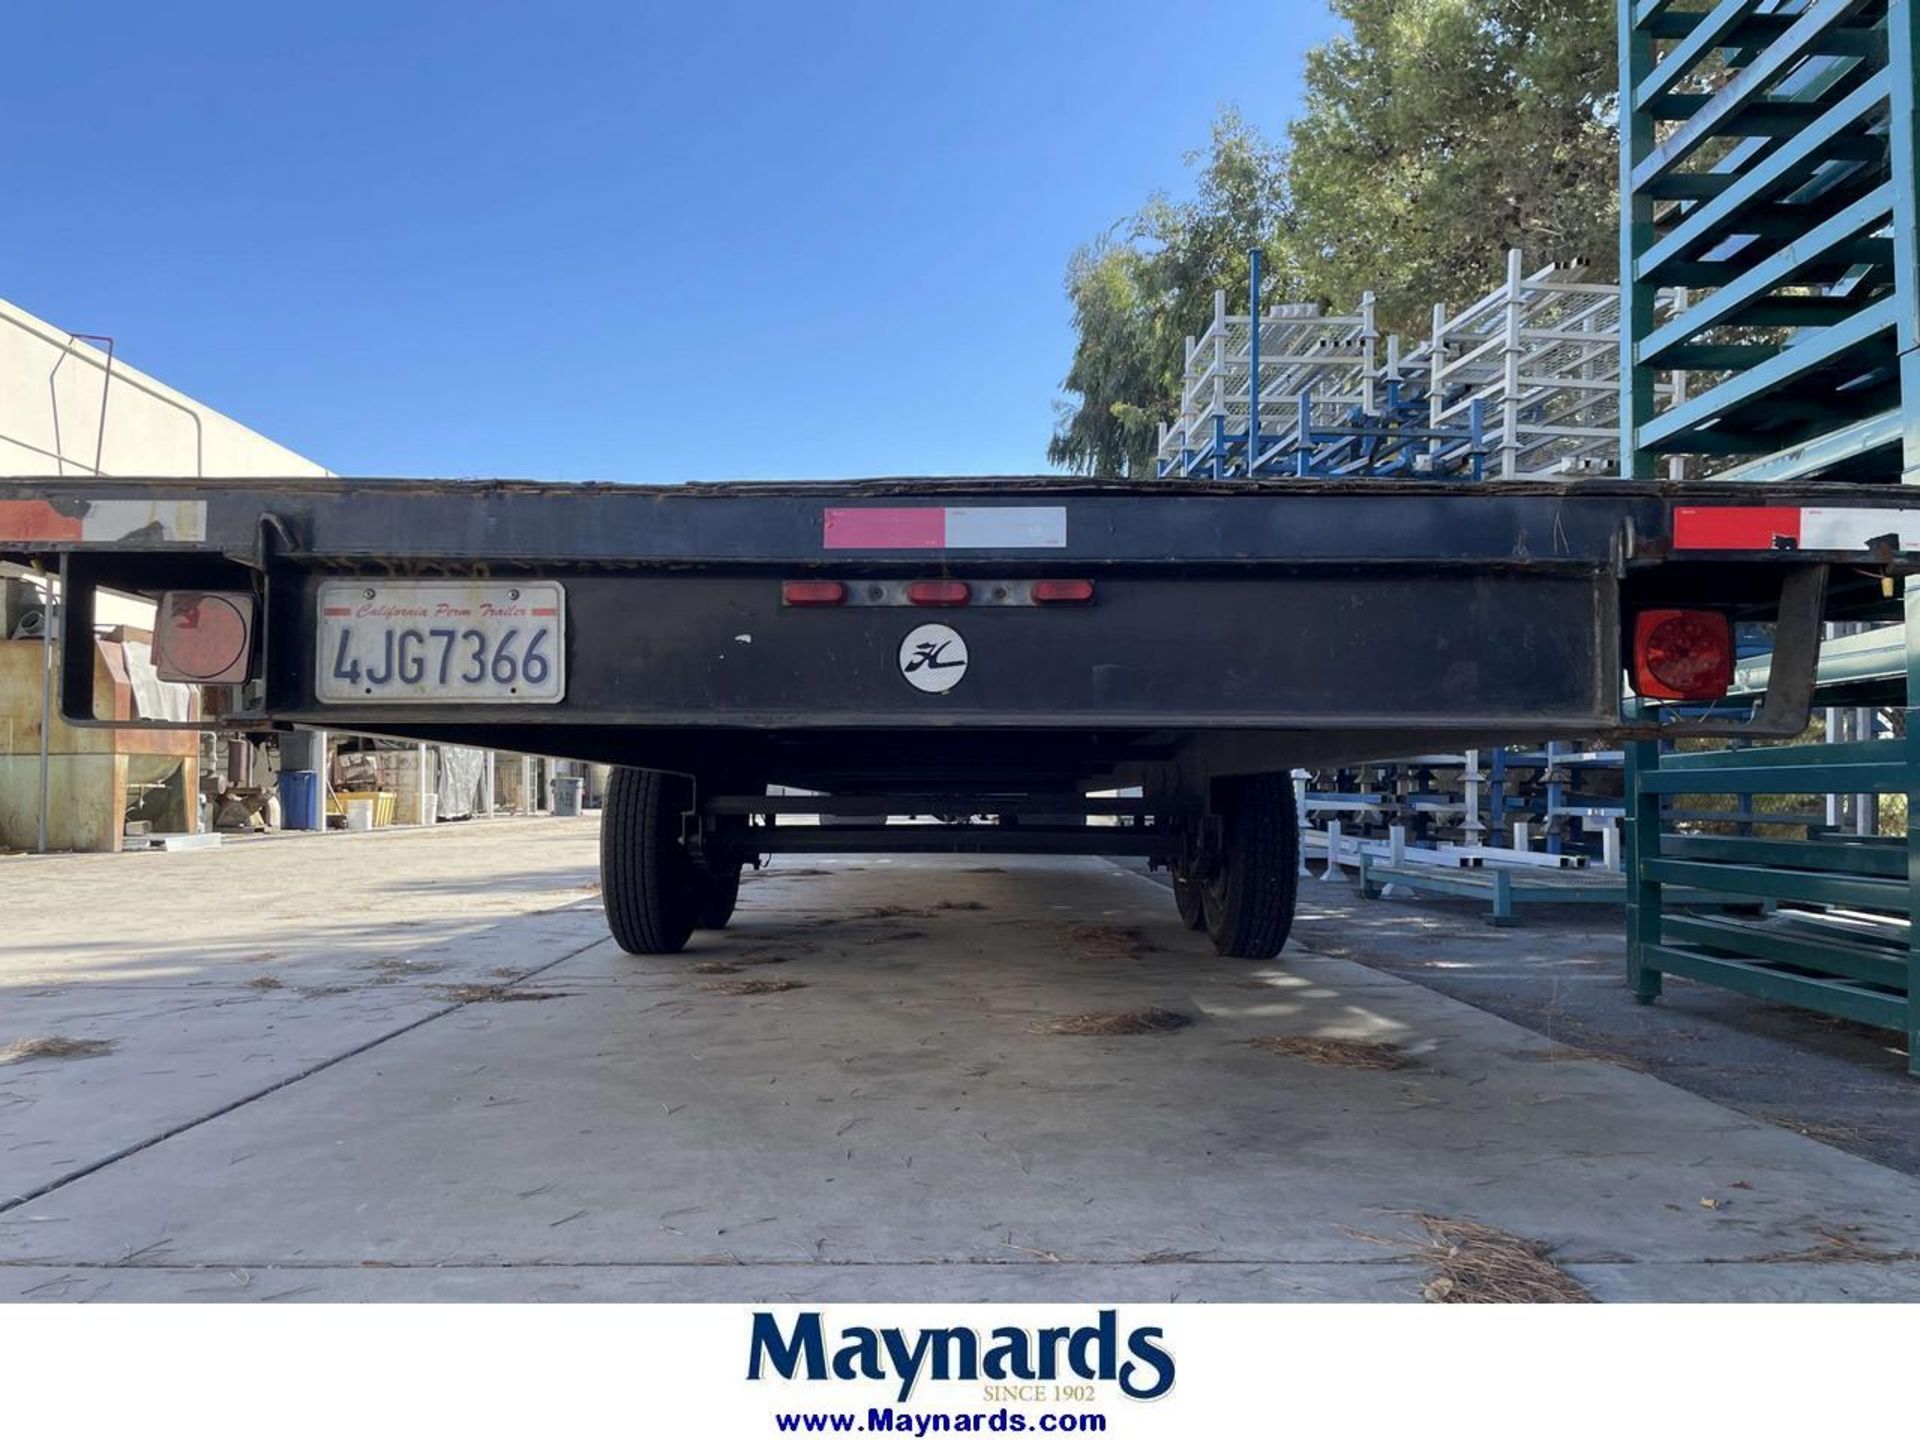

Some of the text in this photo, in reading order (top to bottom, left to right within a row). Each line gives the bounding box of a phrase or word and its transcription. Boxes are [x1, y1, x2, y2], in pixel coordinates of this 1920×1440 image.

[356, 603, 528, 619] California Perm Trailer
[333, 628, 548, 685] 4JG7366
